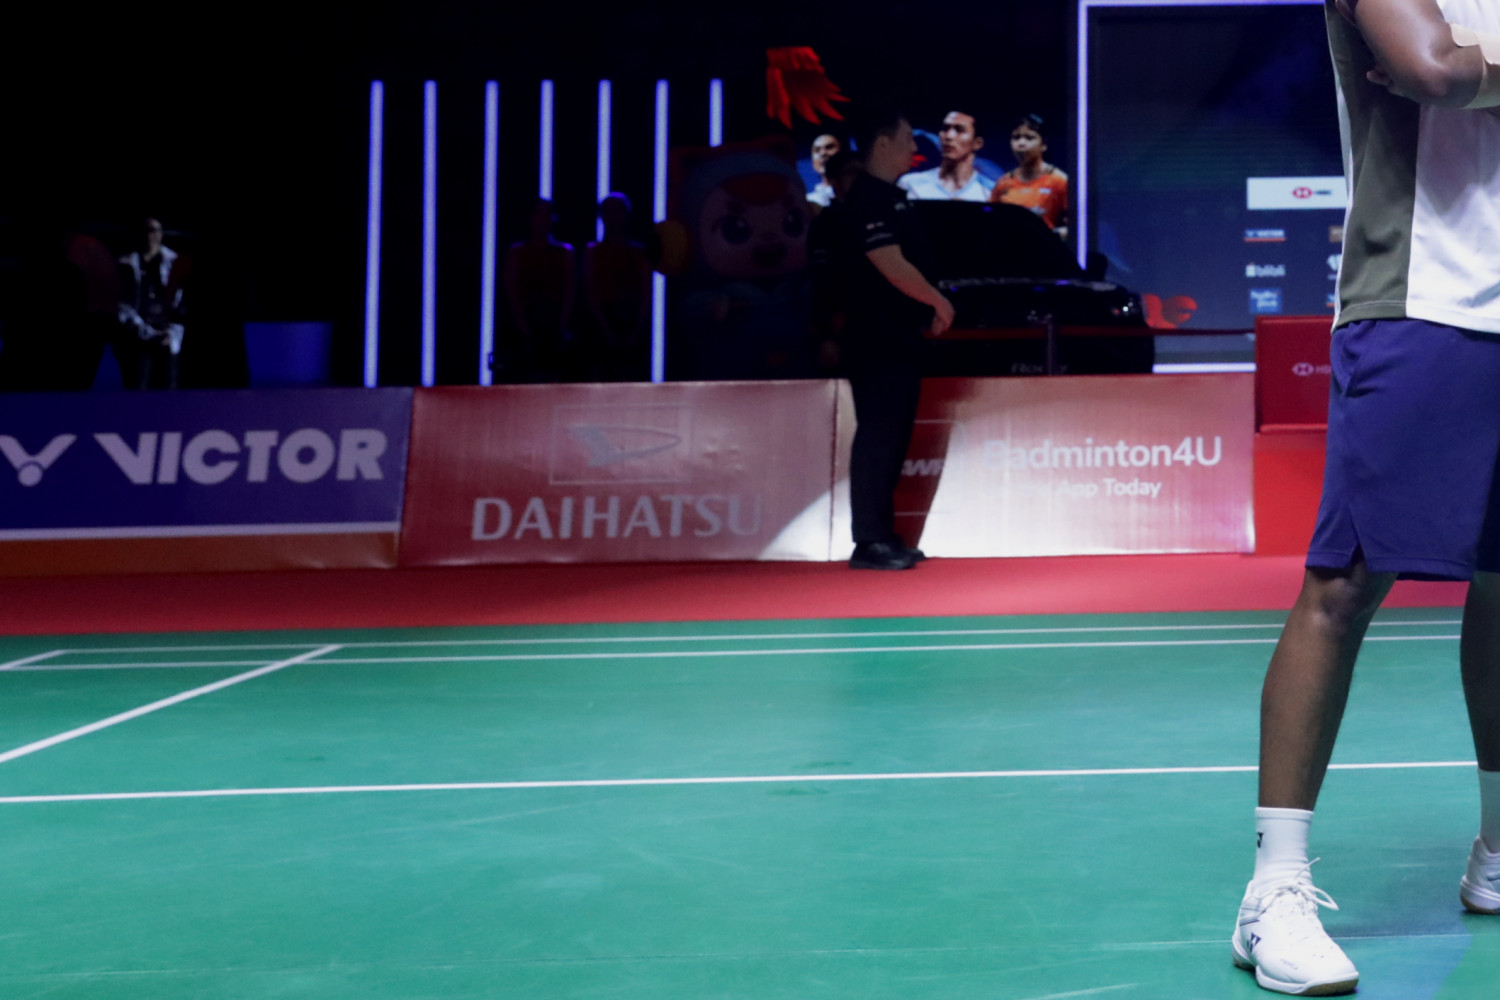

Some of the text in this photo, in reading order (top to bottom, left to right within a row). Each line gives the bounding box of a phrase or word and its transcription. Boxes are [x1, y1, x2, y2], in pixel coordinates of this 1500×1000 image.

[94, 428, 388, 485] VICTOR
[983, 435, 1221, 469] Badminton4U
[1057, 479, 1098, 499] App
[1103, 477, 1162, 499] Today
[471, 492, 762, 542] DAIHATSU
